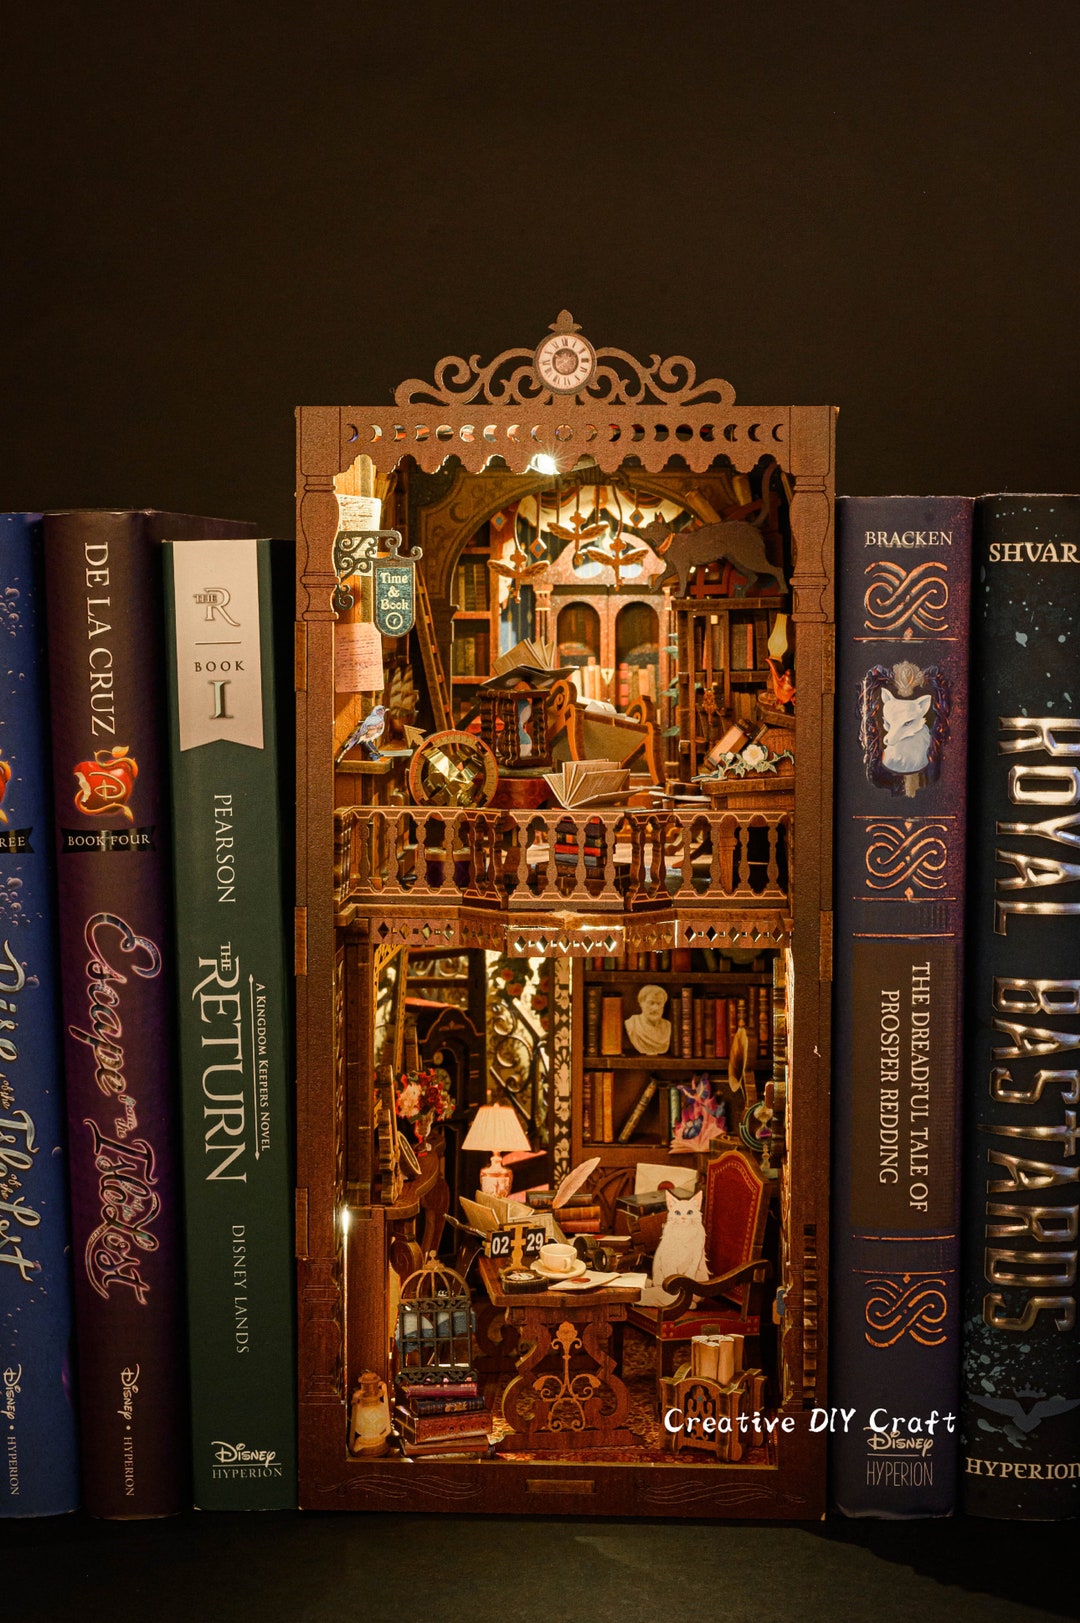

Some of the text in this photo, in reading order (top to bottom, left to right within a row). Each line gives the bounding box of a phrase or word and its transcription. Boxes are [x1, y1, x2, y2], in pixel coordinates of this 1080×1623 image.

[864, 531, 953, 547] BRACKEN
[380, 572, 409, 584] Time
[387, 586, 400, 598] &
[380, 598, 409, 610] Book
[84, 542, 116, 737] DE LA CRUZ
[194, 661, 245, 673] BOOK
[208, 680, 234, 720] I
[67, 834, 151, 847] BOOK FOUR
[213, 794, 236, 903] PEARSON
[220, 941, 232, 971] THE
[69, 912, 163, 1097] Escape
[976, 716, 1080, 1333] ROYAL BASTARDS
[192, 955, 247, 1183] RETURN
[256, 982, 271, 1151] A KINGDOM KEEPERS NOVEL
[909, 961, 931, 1212] THE DREADFUL TALE OF
[879, 989, 900, 1185] PROSPER REDDING
[83, 1118, 159, 1205] Isle
[84, 1193, 161, 1306] Lost
[491, 1236, 510, 1255] 02
[526, 1232, 544, 1251] 29
[231, 1224, 249, 1353] DISNEY LANDS
[0, 1363, 22, 1495] Disney HYPERION
[117, 1363, 140, 1496] Disney HYPERION
[863, 1426, 934, 1458] Disney
[211, 1440, 276, 1467] Disney
[212, 1467, 283, 1479] HYPERION
[866, 1460, 933, 1487] HYPERION
